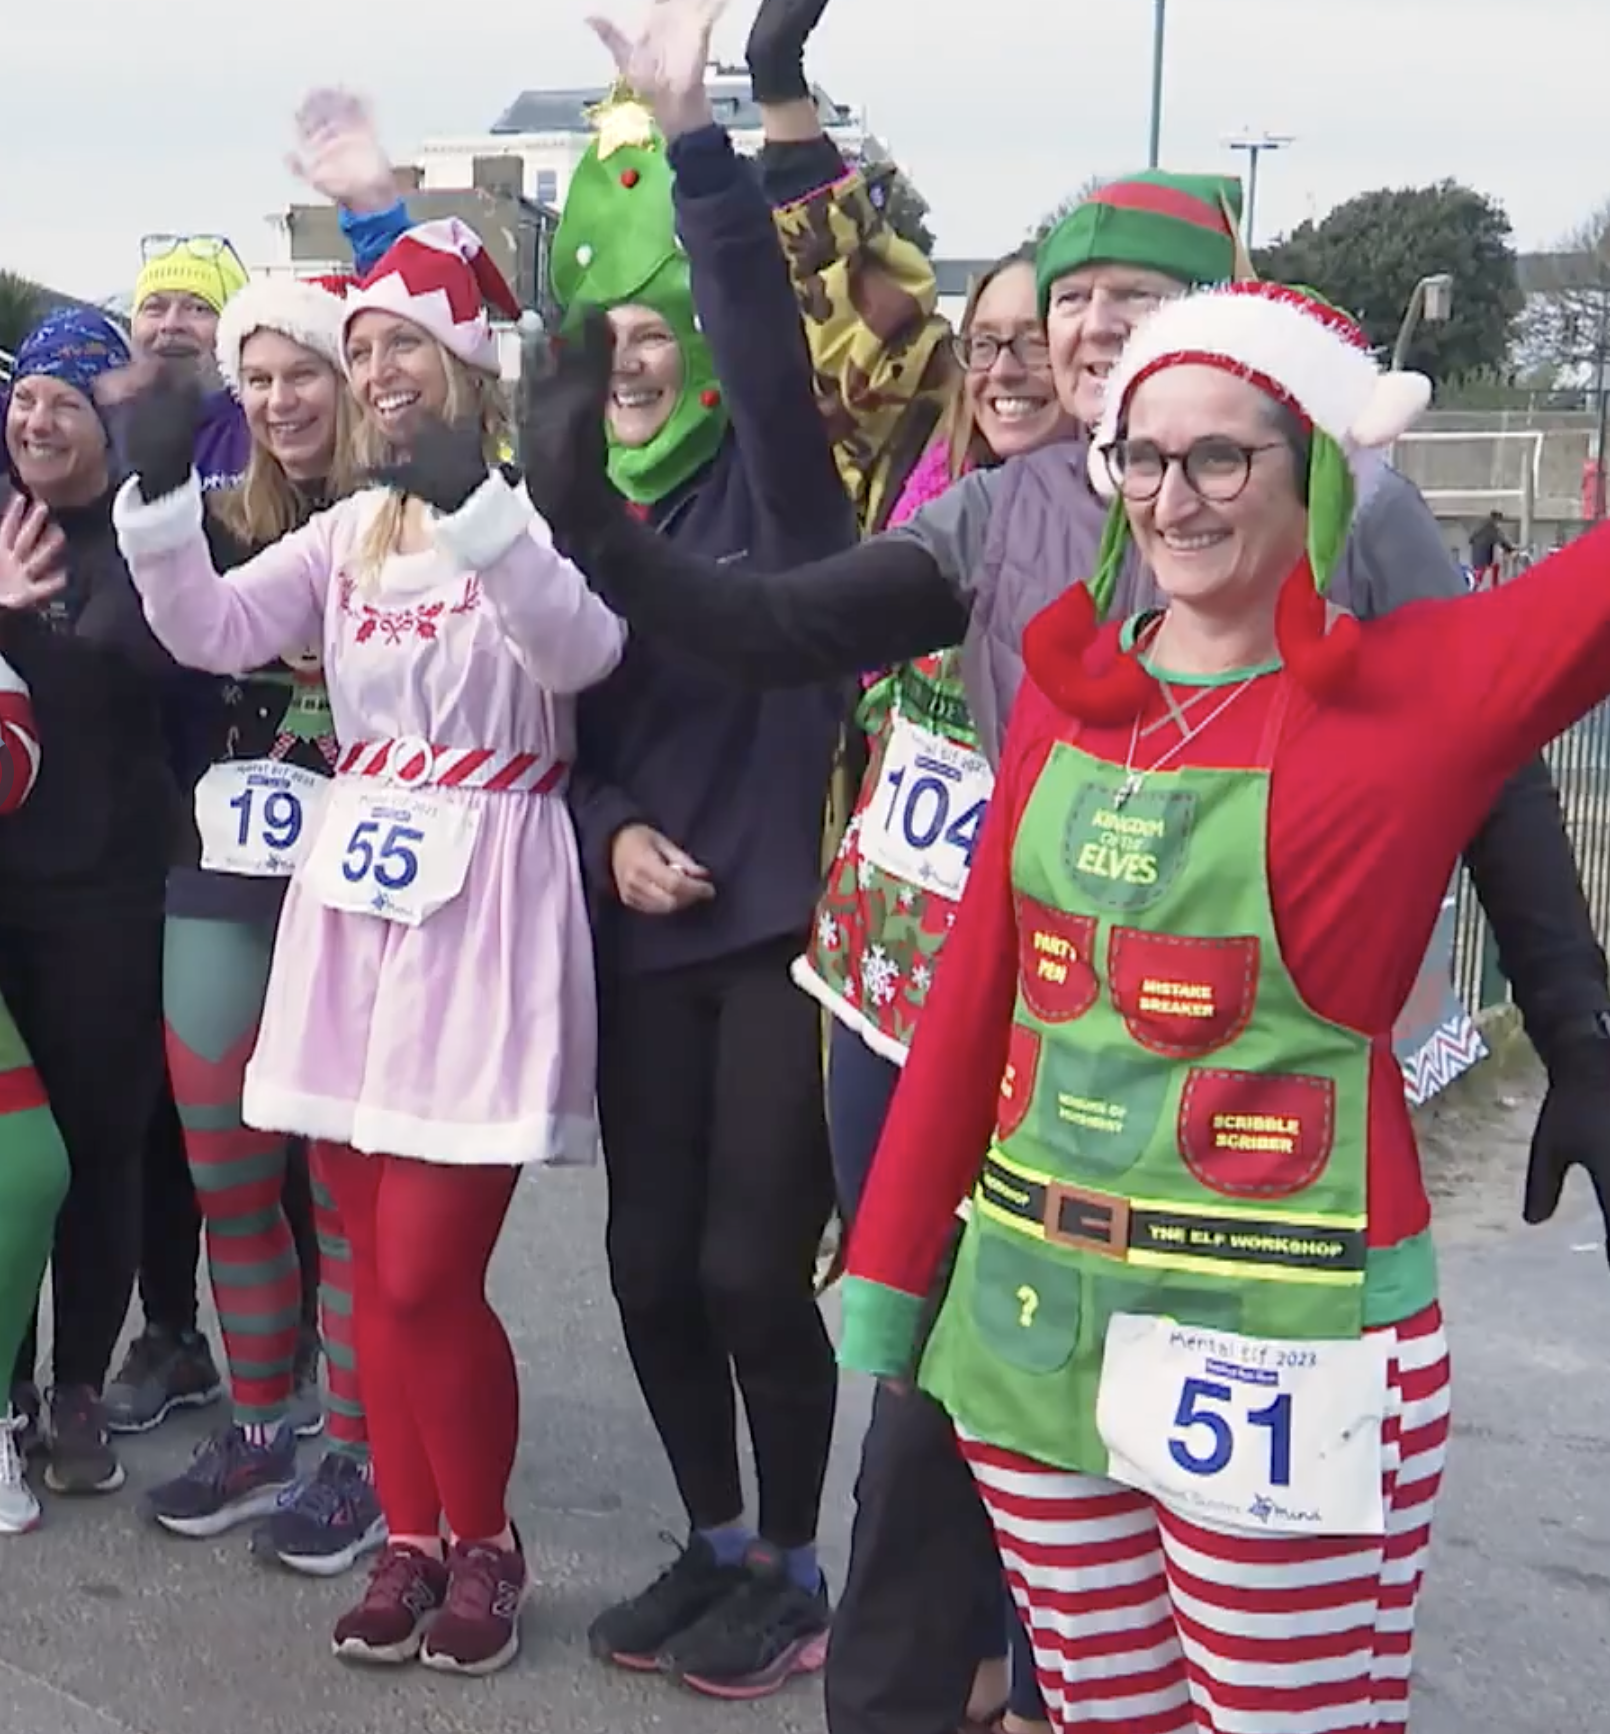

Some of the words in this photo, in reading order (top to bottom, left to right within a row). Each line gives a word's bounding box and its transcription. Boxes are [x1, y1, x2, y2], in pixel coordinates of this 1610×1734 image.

[229, 787, 304, 851] 19
[883, 764, 992, 868] 104
[341, 820, 425, 891] 55
[1076, 843, 1159, 885] ELVES
[1139, 995, 1215, 1018] BREAKER
[1142, 978, 1213, 1000] MISTAKE
[1213, 1113, 1300, 1136] SCRIBBLE
[1215, 1132, 1294, 1155] SCRIBER
[1148, 1224, 1187, 1243] THE
[1190, 1229, 1227, 1248] ELF
[1229, 1235, 1344, 1259] WORKSHOP
[1275, 1348, 1317, 1368] 2023
[1167, 1375, 1293, 1488] 51
